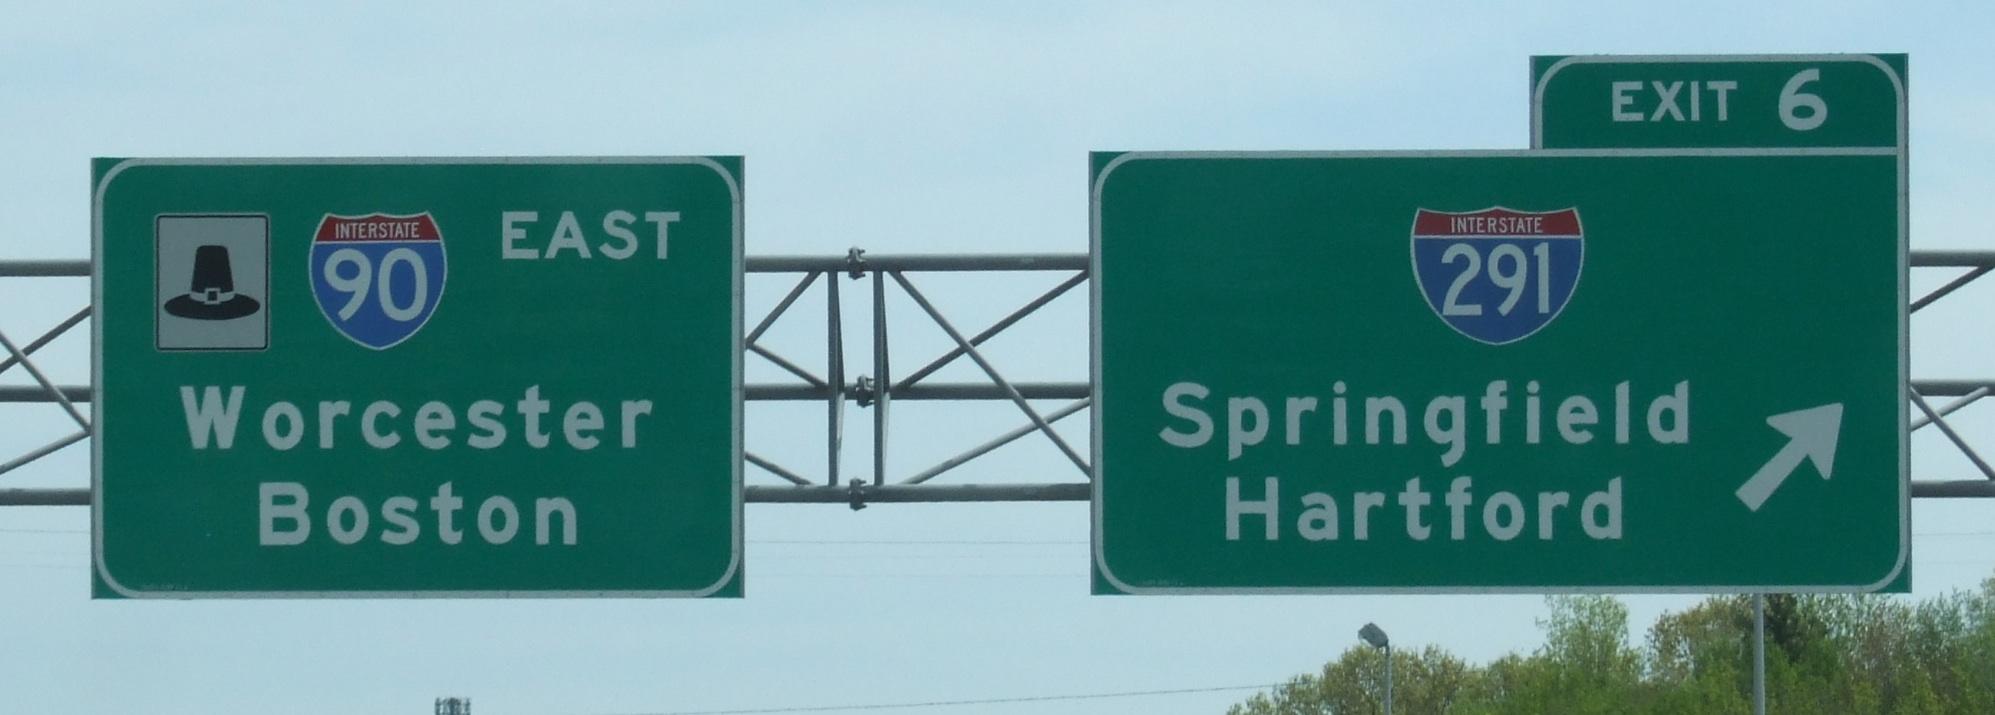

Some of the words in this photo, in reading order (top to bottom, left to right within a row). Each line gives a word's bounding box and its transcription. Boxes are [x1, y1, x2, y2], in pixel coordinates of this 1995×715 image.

[1612, 81, 1738, 122] EXIT
[1779, 69, 1828, 131] 6
[334, 221, 420, 240] INTERSTATE
[501, 210, 681, 260] EAST
[1451, 215, 1544, 235] INTERSTATE
[323, 247, 428, 322] 90
[1442, 242, 1550, 317] 291
[180, 385, 653, 450] Worcester
[1159, 380, 1690, 467] Springfield
[259, 482, 578, 546] Boston
[1225, 476, 1624, 541] Hartford
